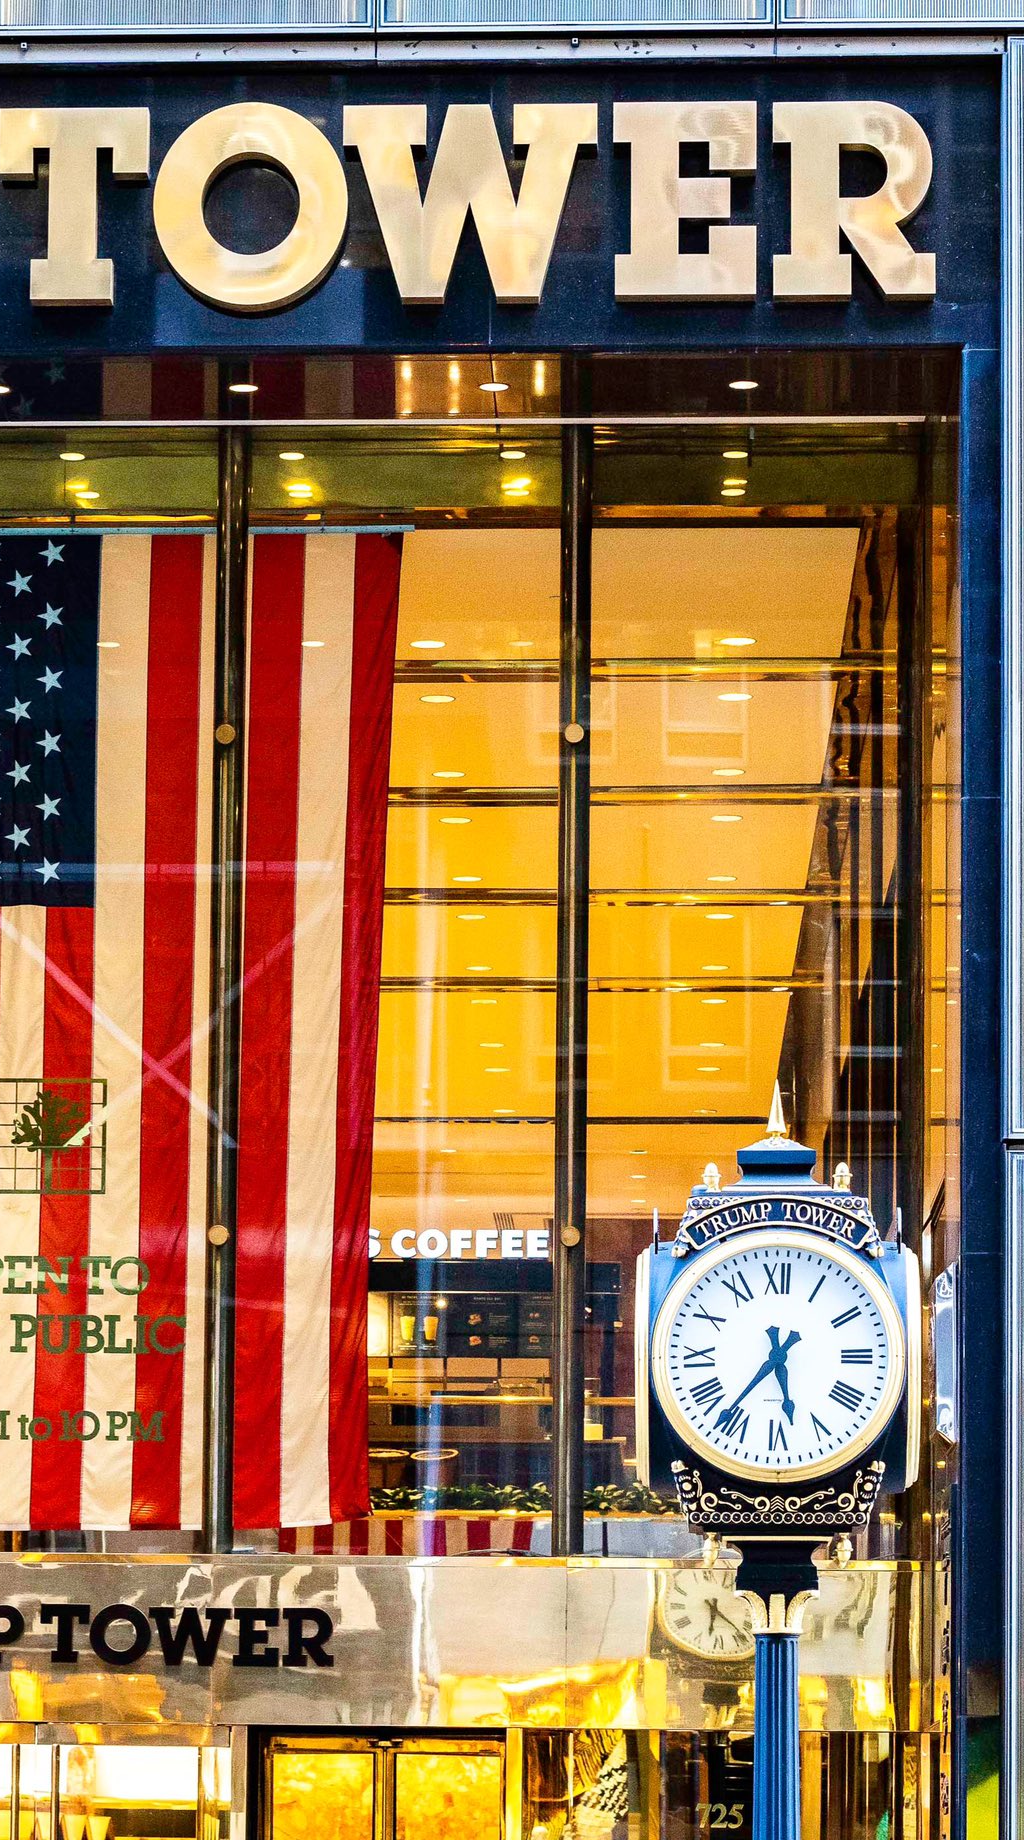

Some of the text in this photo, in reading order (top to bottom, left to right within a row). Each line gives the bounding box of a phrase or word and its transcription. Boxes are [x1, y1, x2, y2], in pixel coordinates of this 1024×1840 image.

[696, 1202, 856, 1239] TRUMP TOWER
[390, 1228, 550, 1258] COFFEE
[80, 1256, 150, 1295] TO
[10, 1313, 187, 1354] PUBLIC
[17, 1414, 52, 1441] to
[59, 1410, 101, 1441] 10
[106, 1411, 165, 1442] PM
[40, 1603, 335, 1667] TOWER
[695, 1803, 745, 1829] 725
